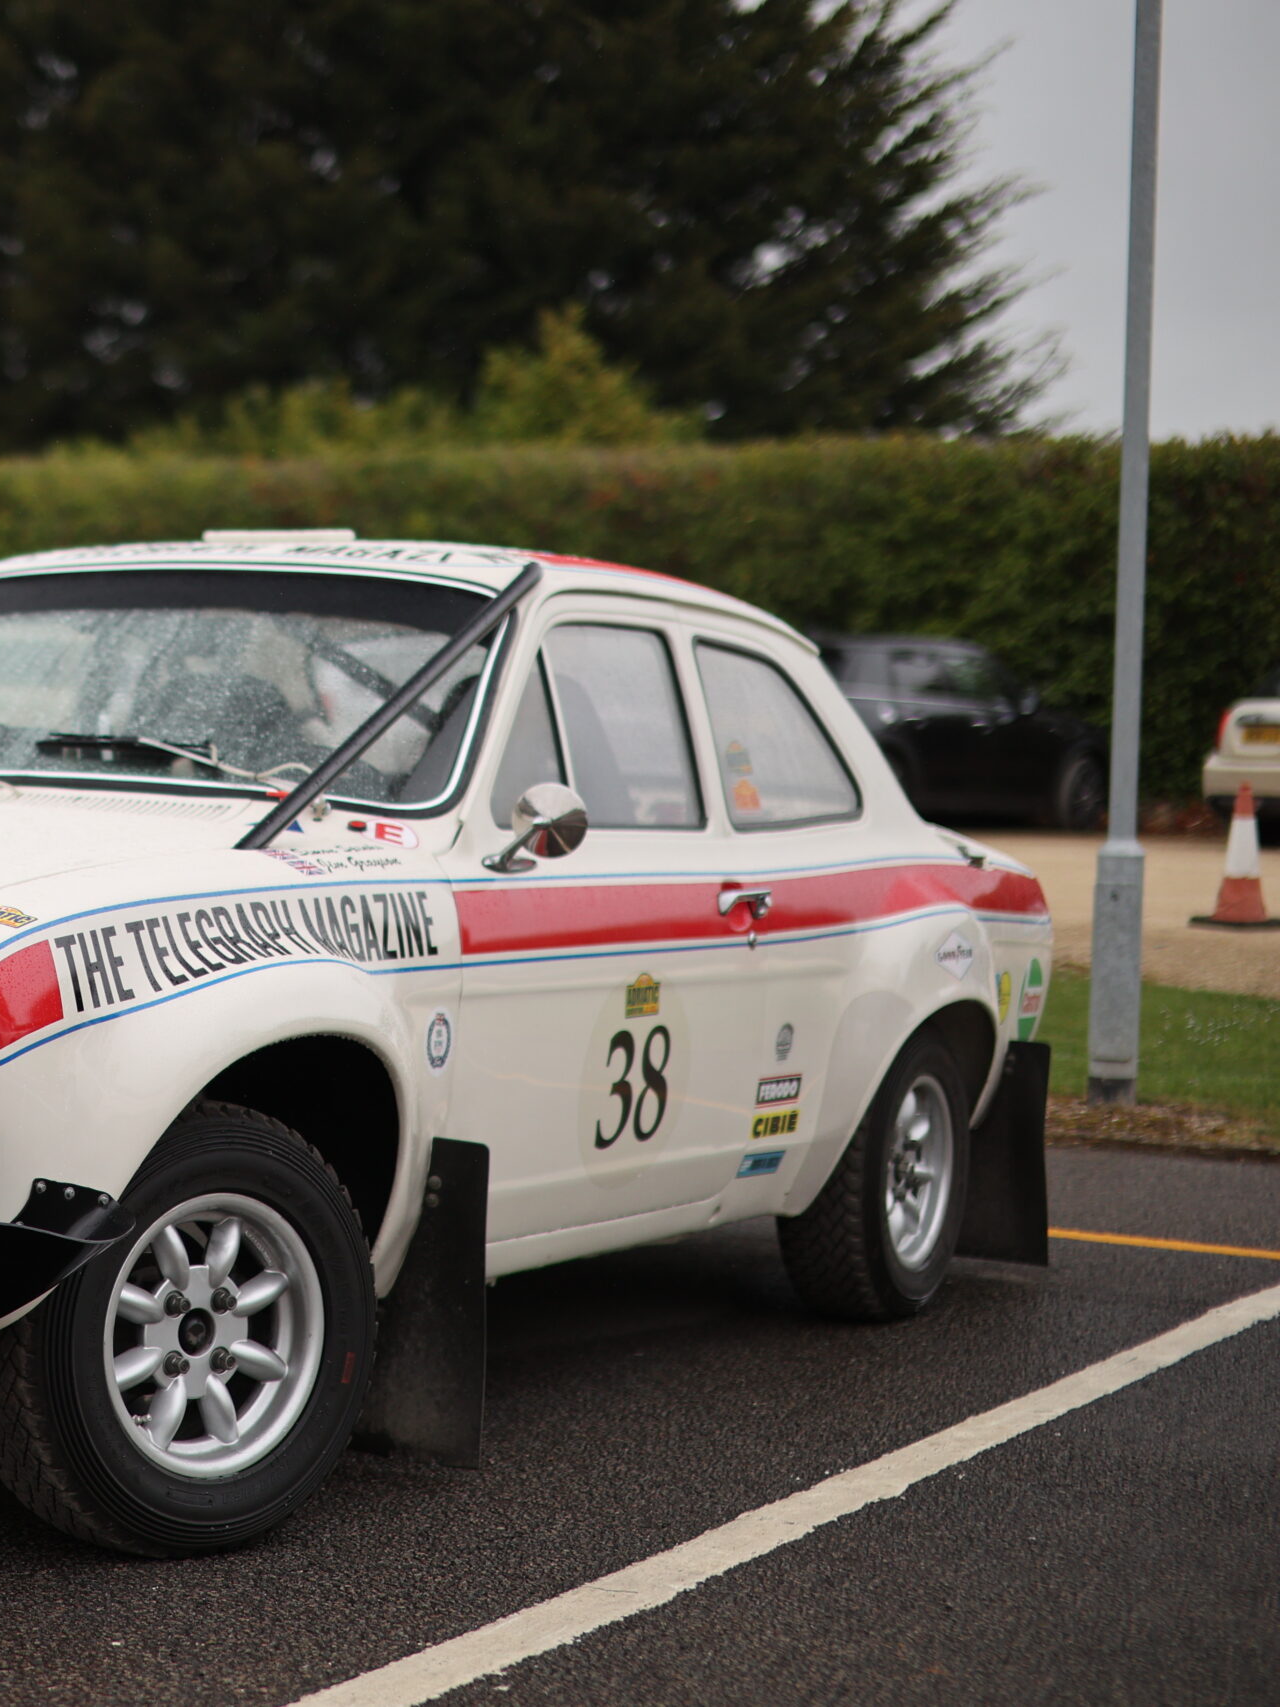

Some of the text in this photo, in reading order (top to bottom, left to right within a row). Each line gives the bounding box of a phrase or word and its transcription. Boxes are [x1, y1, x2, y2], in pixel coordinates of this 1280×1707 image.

[374, 822, 404, 846] E
[54, 890, 439, 1013] THE TELEGRAPH MAGAZINE
[594, 1024, 671, 1150] 38
[759, 1079, 799, 1102] FERODO
